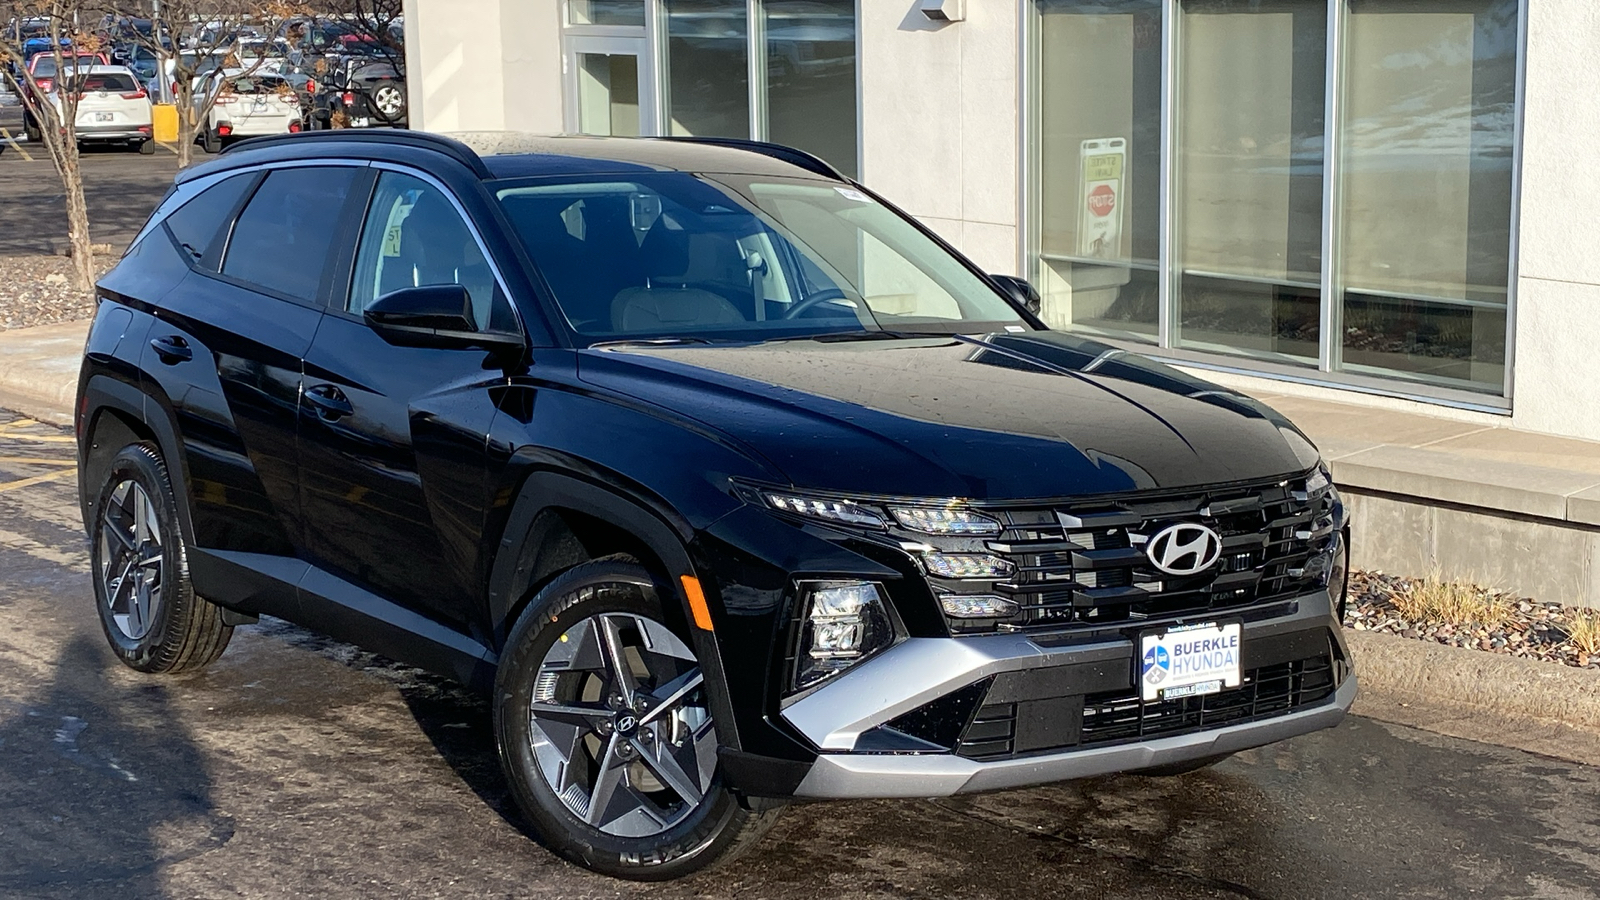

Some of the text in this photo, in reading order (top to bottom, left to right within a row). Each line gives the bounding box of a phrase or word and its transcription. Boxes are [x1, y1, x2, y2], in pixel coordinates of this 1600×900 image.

[1173, 635, 1238, 657] BUERKLE
[1172, 649, 1238, 676] HYUNDAI
[1165, 685, 1196, 698] BUERKLE
